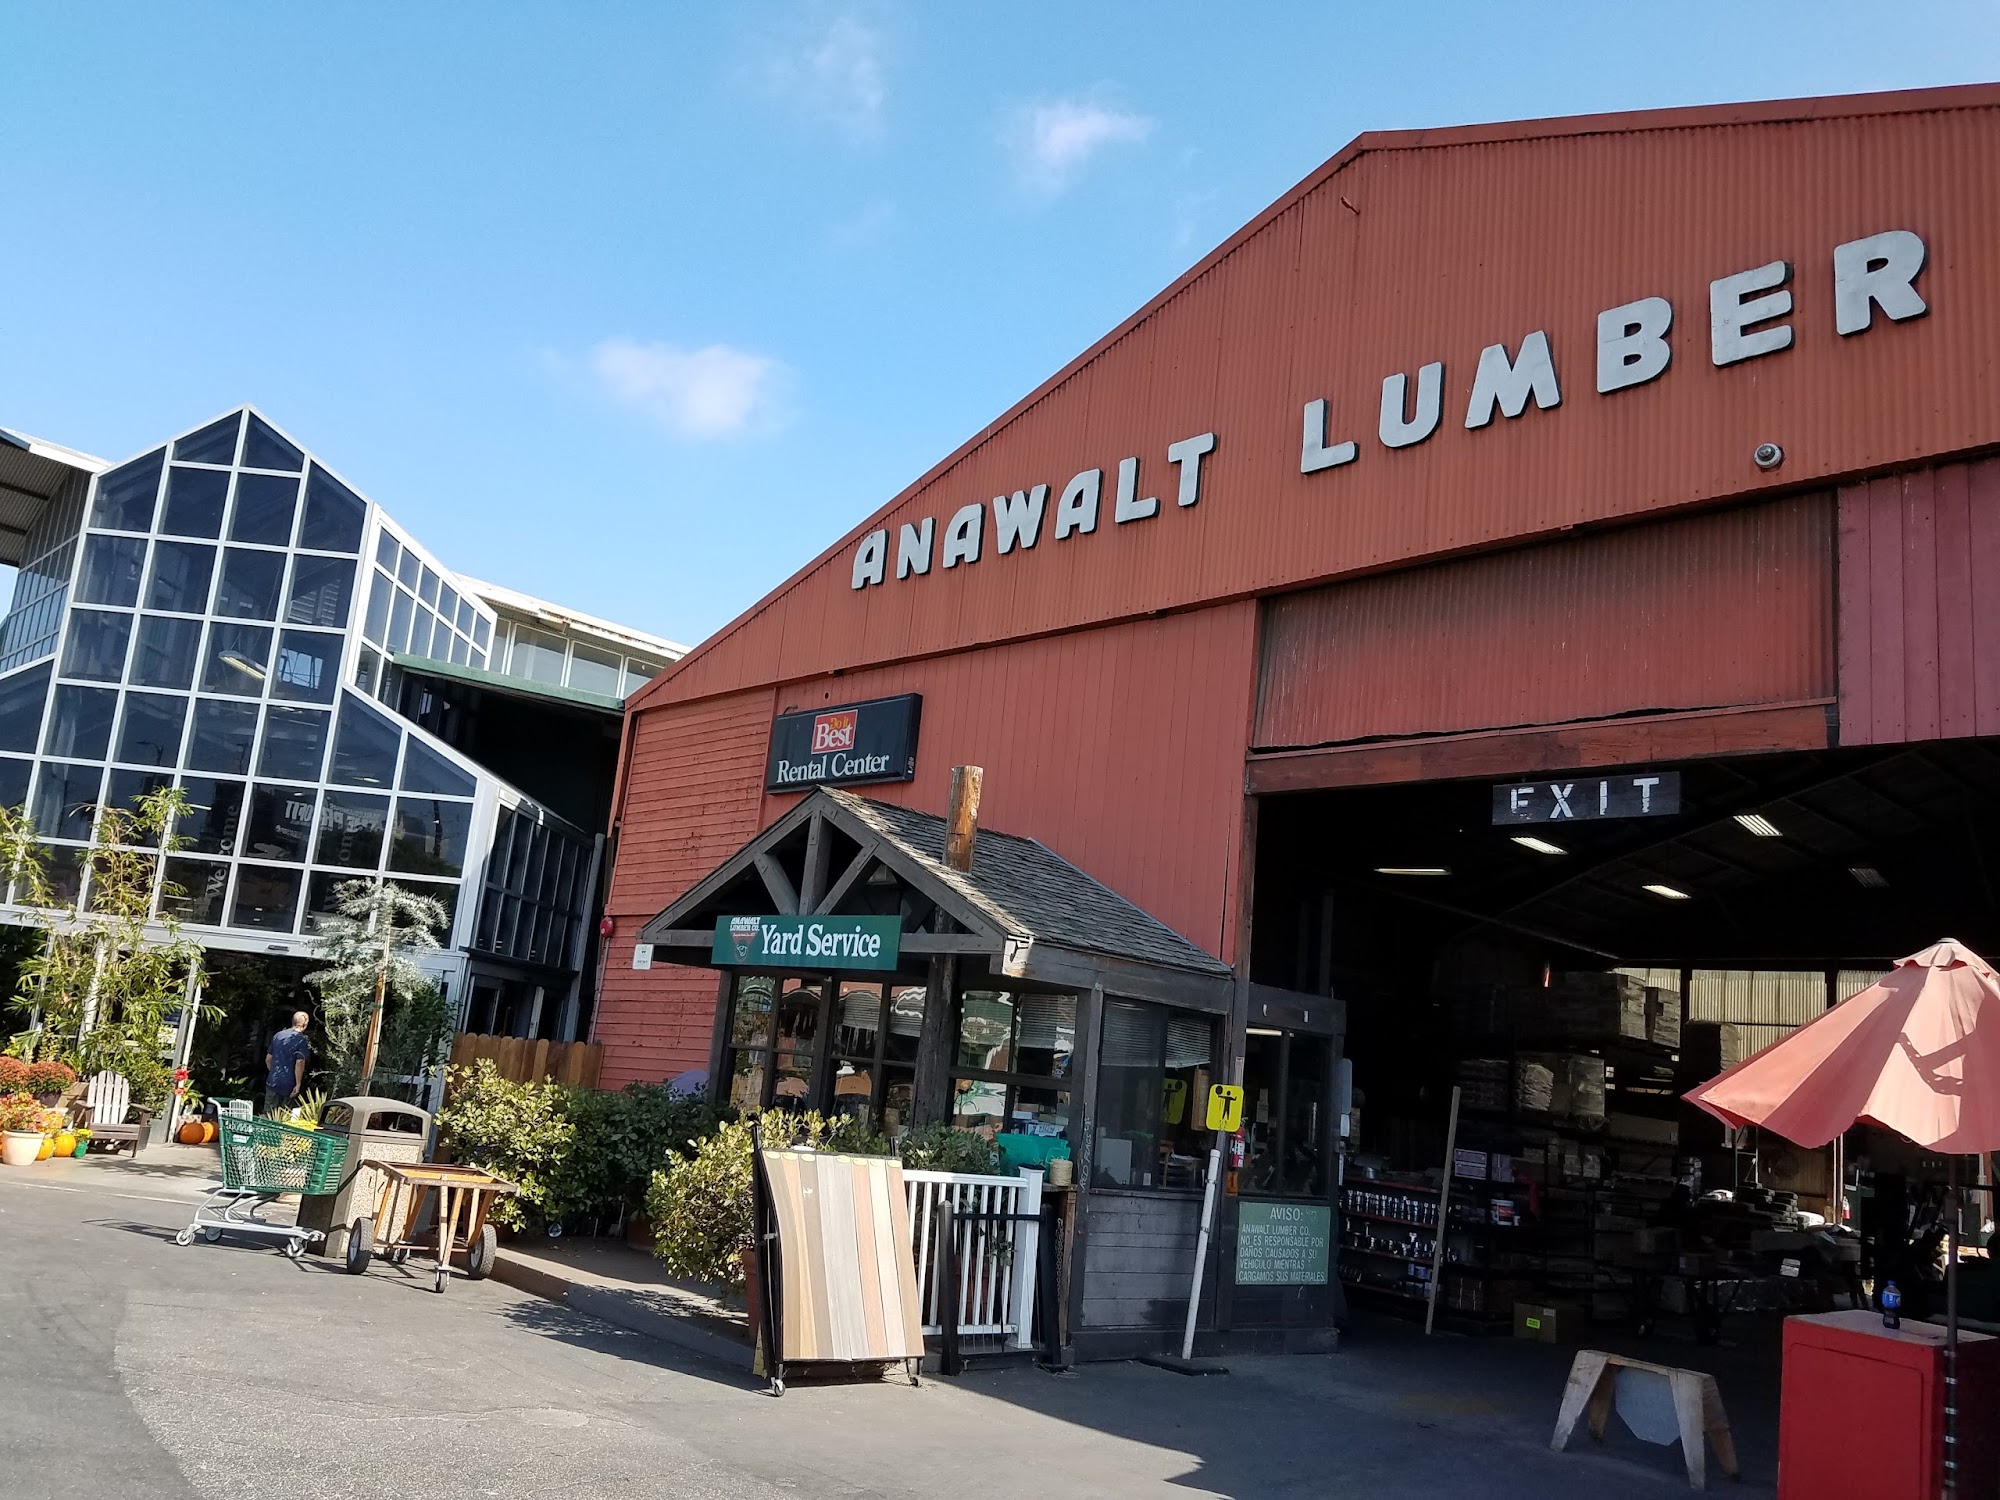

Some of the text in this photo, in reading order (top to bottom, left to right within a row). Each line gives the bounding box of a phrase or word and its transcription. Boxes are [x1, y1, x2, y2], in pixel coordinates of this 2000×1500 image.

[851, 229, 1929, 590] ANAWALT LUMBER
[830, 717, 841, 730] Do
[814, 722, 853, 750] Best
[776, 754, 827, 784] Rental
[831, 752, 890, 777] Center
[1508, 776, 1661, 820] EXIT
[730, 916, 761, 925] ANAWALT
[729, 924, 751, 932] LUMBER
[761, 923, 881, 957] Yard Service
[1270, 1206, 1303, 1221] AVISO:
[1241, 1224, 1270, 1234] ANAWALT
[1272, 1225, 1297, 1235] LUMBER
[1240, 1235, 1324, 1247] NO ES RESPONSABLE POR
[1265, 1247, 1299, 1258] CAUSADOS
[1308, 1249, 1317, 1259] SU
[1239, 1271, 1274, 1281] CARGAMOS
[1276, 1271, 1289, 1281] SUS
